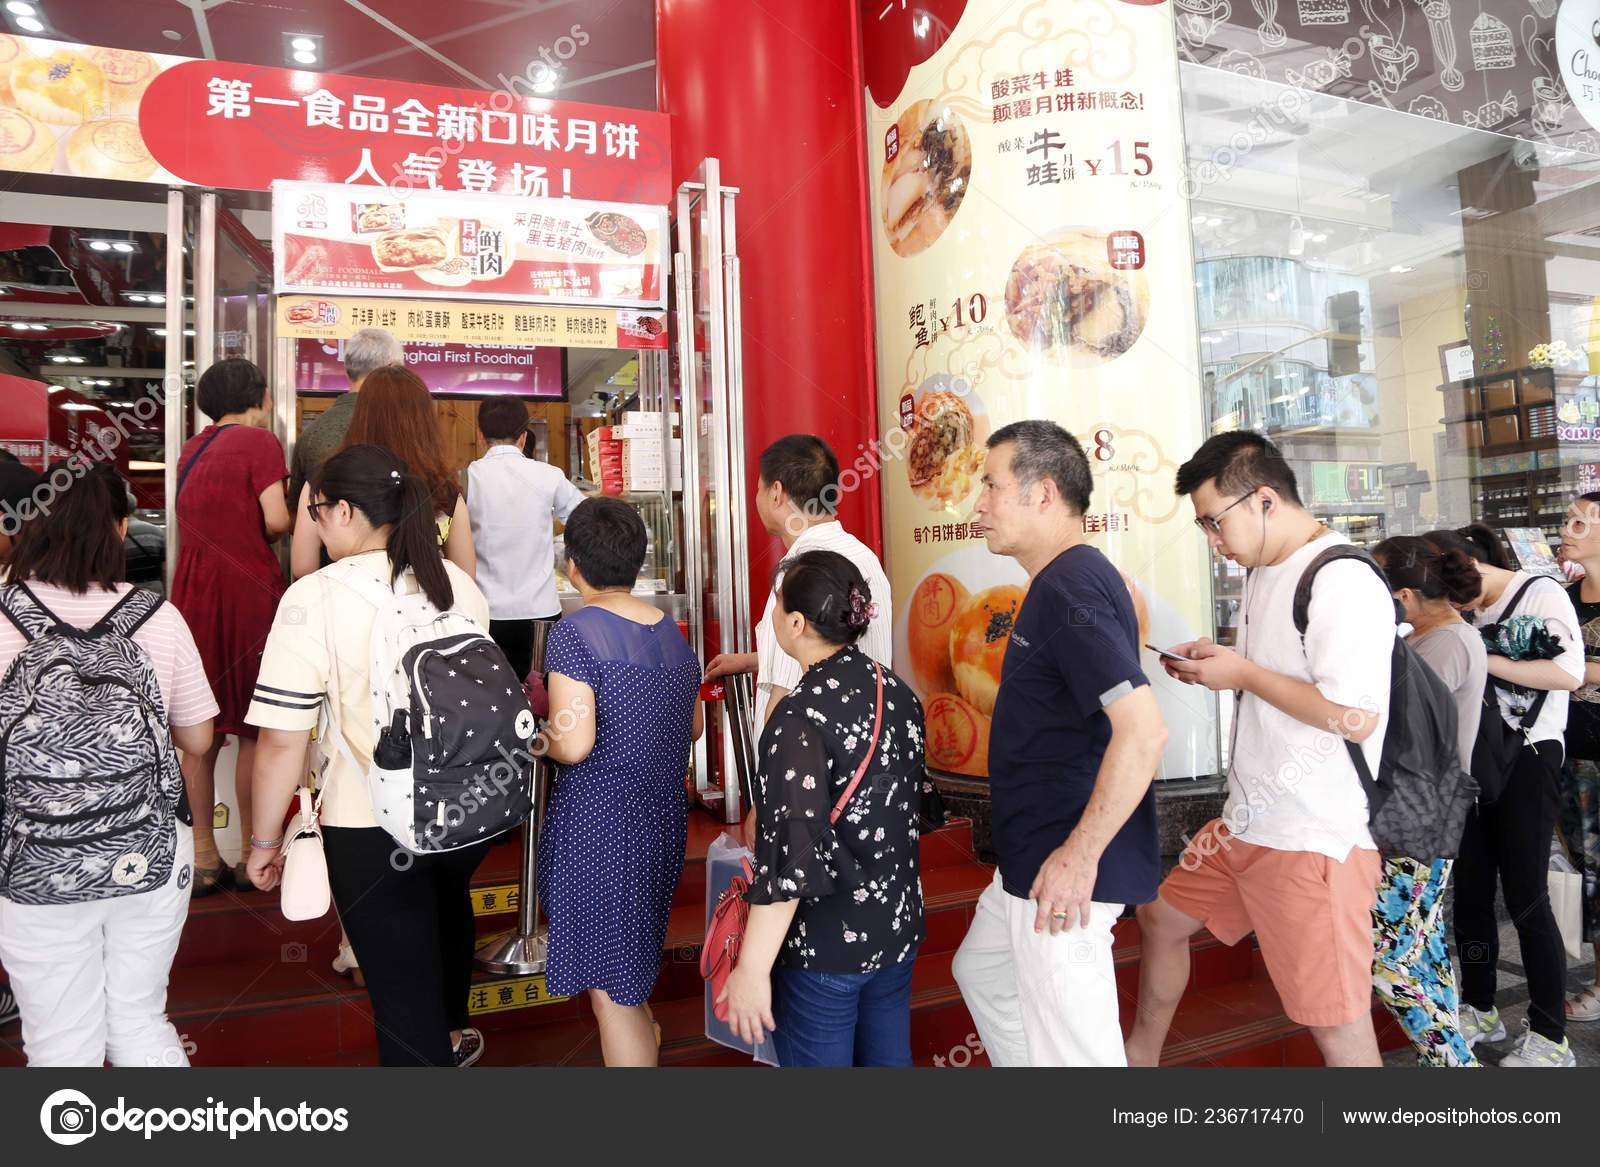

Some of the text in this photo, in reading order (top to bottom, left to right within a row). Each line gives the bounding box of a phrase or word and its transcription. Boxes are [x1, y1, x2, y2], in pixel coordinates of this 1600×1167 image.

[991, 68, 1074, 99] 酸菜牛蛙
[206, 78, 640, 160] 第一食品全新口味月饼
[992, 91, 1144, 124] 颠覆月饼新概念!
[1026, 128, 1066, 186] 牛蛙
[1063, 153, 1075, 181] 月饼
[345, 148, 572, 199] 人气登场!
[479, 230, 503, 275] 鲜肉
[1113, 235, 1139, 250] 新品
[1114, 251, 1140, 265] 上市
[908, 303, 930, 349] 鲍鱼
[403, 350, 533, 365] nghai First Foodhall
[913, 521, 985, 544] 每个月饼都是
[482, 890, 519, 909] 意台
[471, 983, 540, 1009] 注意台
